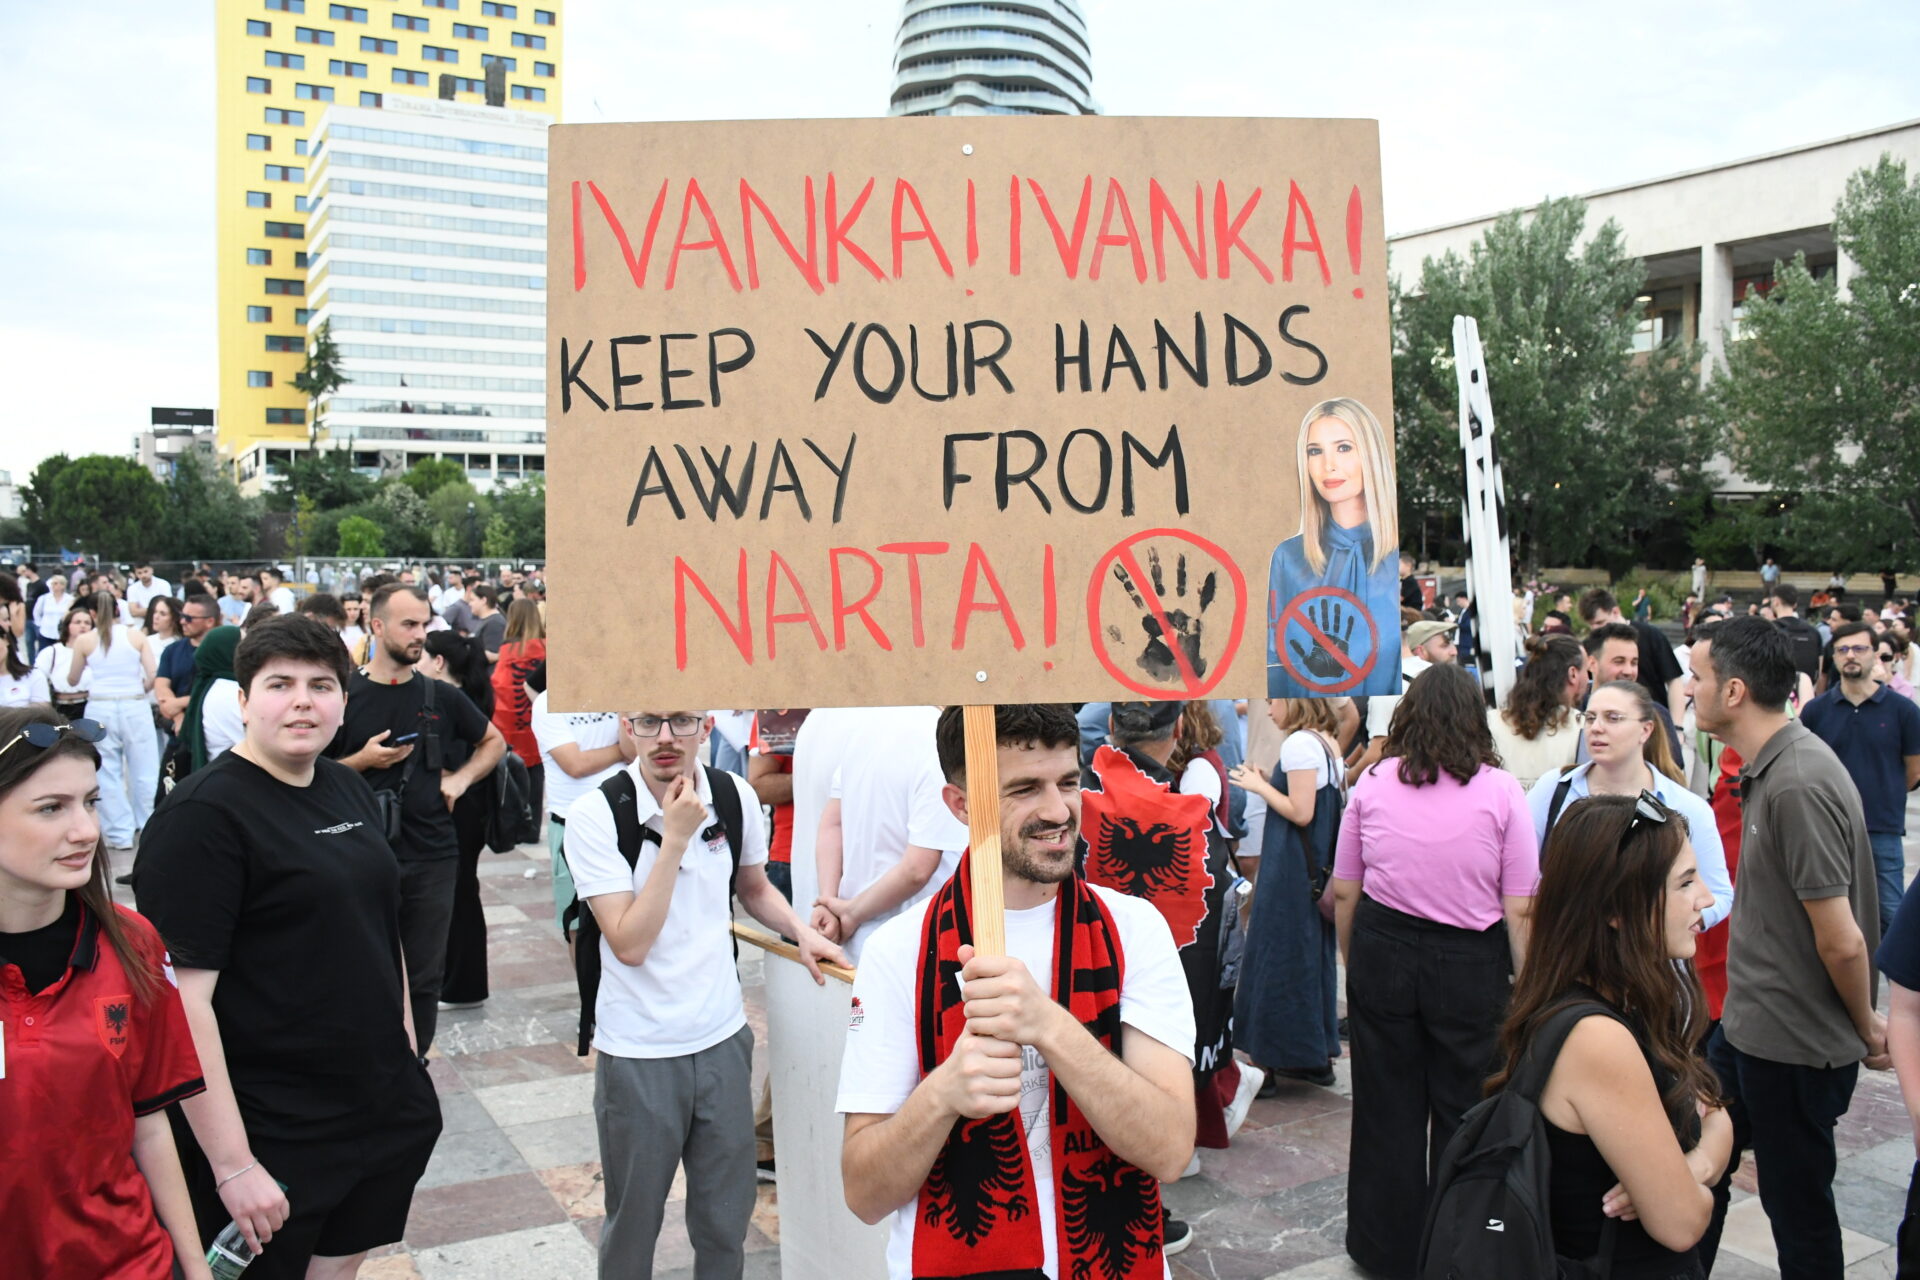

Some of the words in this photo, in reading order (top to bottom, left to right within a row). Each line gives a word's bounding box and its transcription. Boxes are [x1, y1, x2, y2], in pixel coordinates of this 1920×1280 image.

[573, 173, 979, 297] IVANKA!
[1009, 174, 1364, 299] IVANKA!
[561, 328, 754, 413] KEEP
[804, 319, 1014, 403] YOUR
[1056, 304, 1328, 394] HANDS
[627, 431, 856, 526] AWAY
[943, 424, 1189, 516] FROM
[674, 541, 1058, 673] NARTA!
